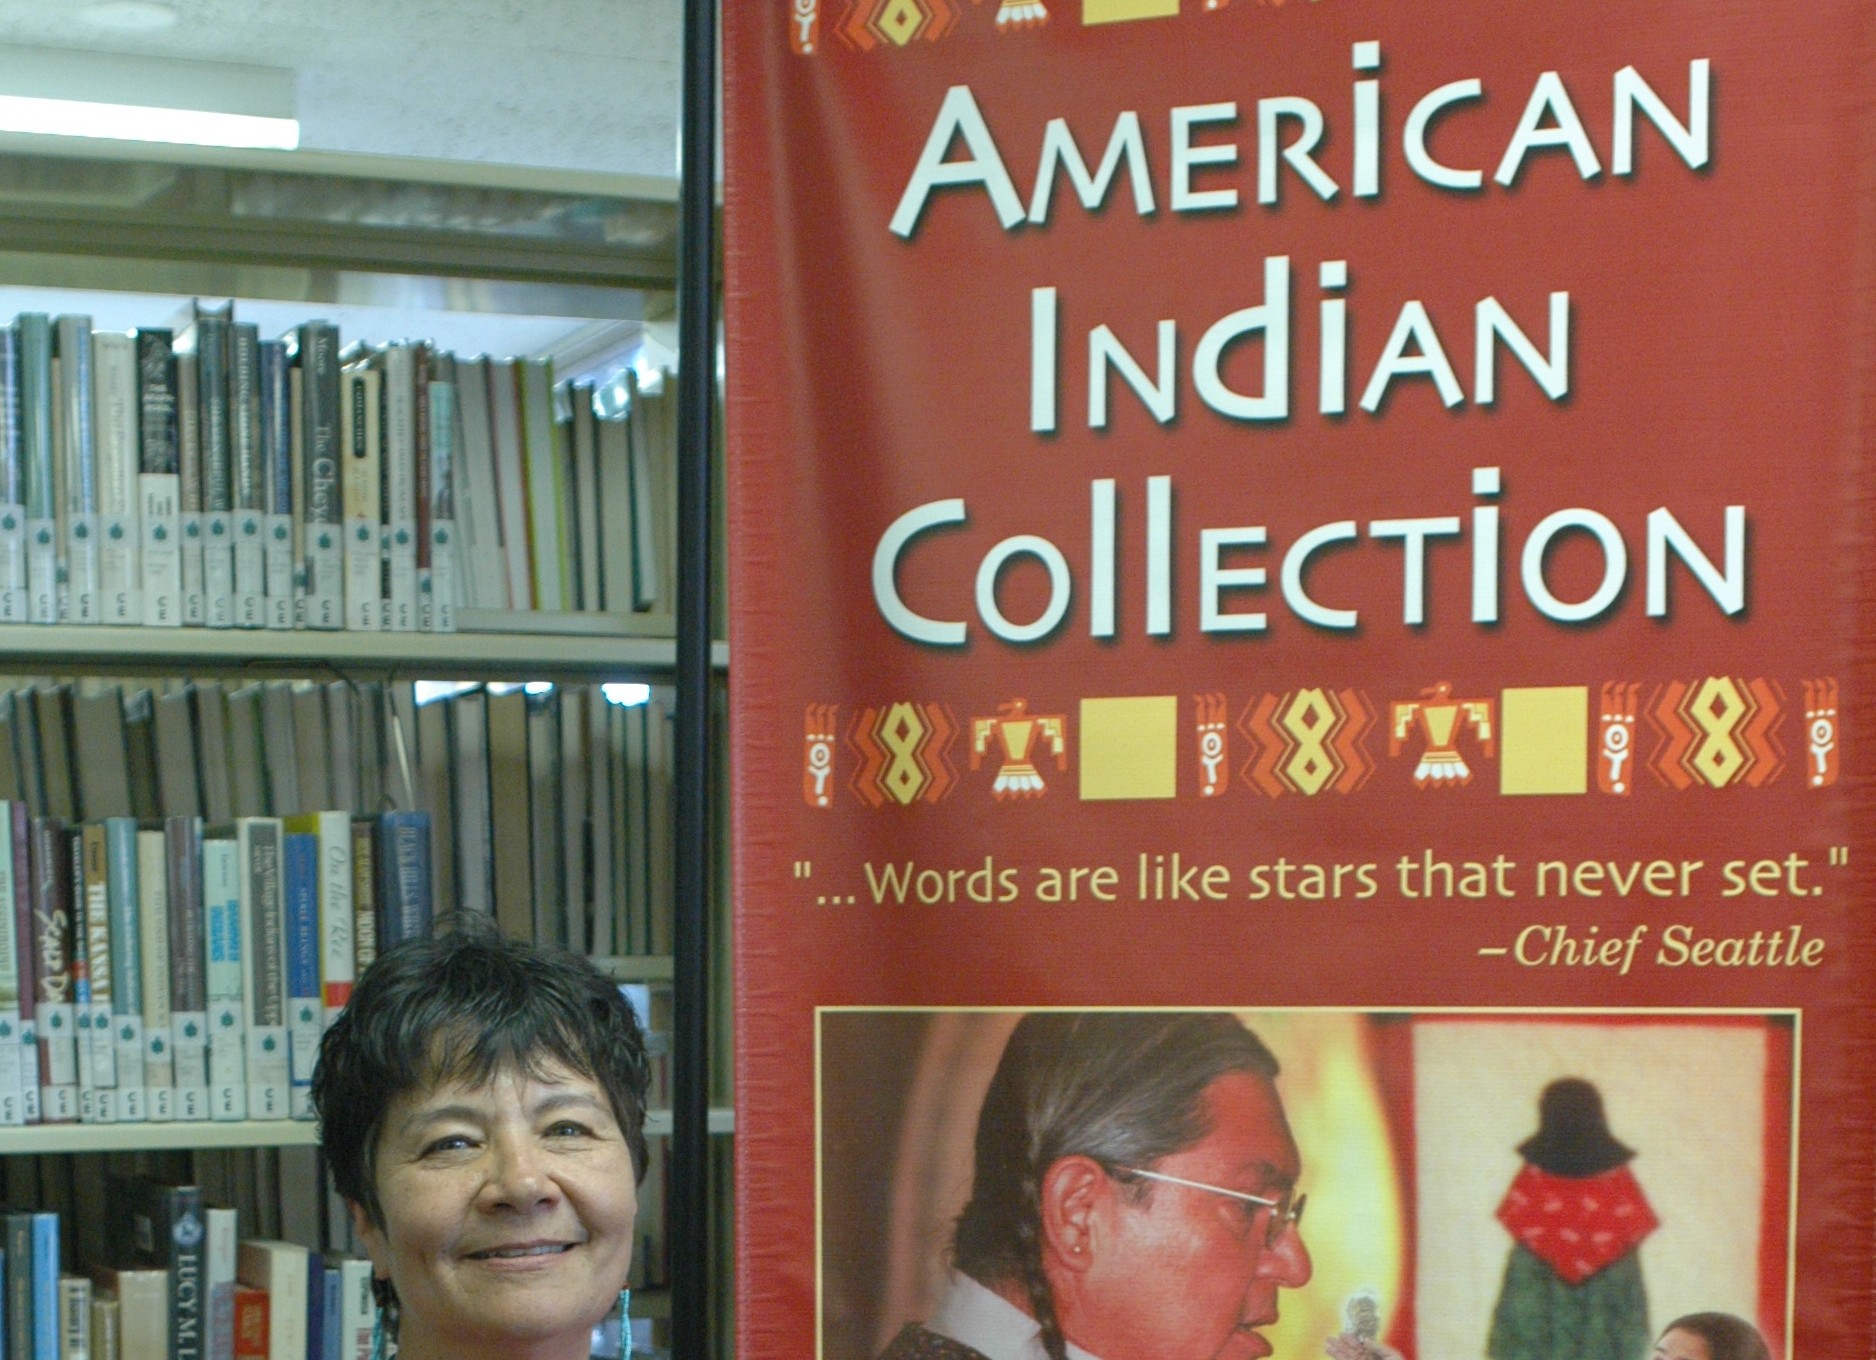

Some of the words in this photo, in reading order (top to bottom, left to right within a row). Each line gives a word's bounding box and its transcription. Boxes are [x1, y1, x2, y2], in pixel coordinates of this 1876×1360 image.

[317, 337, 328, 375] Moore
[316, 425, 331, 452] The
[329, 847, 347, 875] On
[398, 827, 418, 865] BLACK
[261, 868, 277, 907] Village
[1036, 867, 1119, 901] are
[1140, 853, 1231, 900] like
[1249, 858, 1378, 899] stars
[1396, 849, 1516, 897] that
[1537, 861, 1704, 896] never
[330, 881, 348, 911] the
[1657, 925, 1825, 966] Seattle
[178, 1254, 197, 1309] LUCY
[178, 1318, 197, 1344] M.
